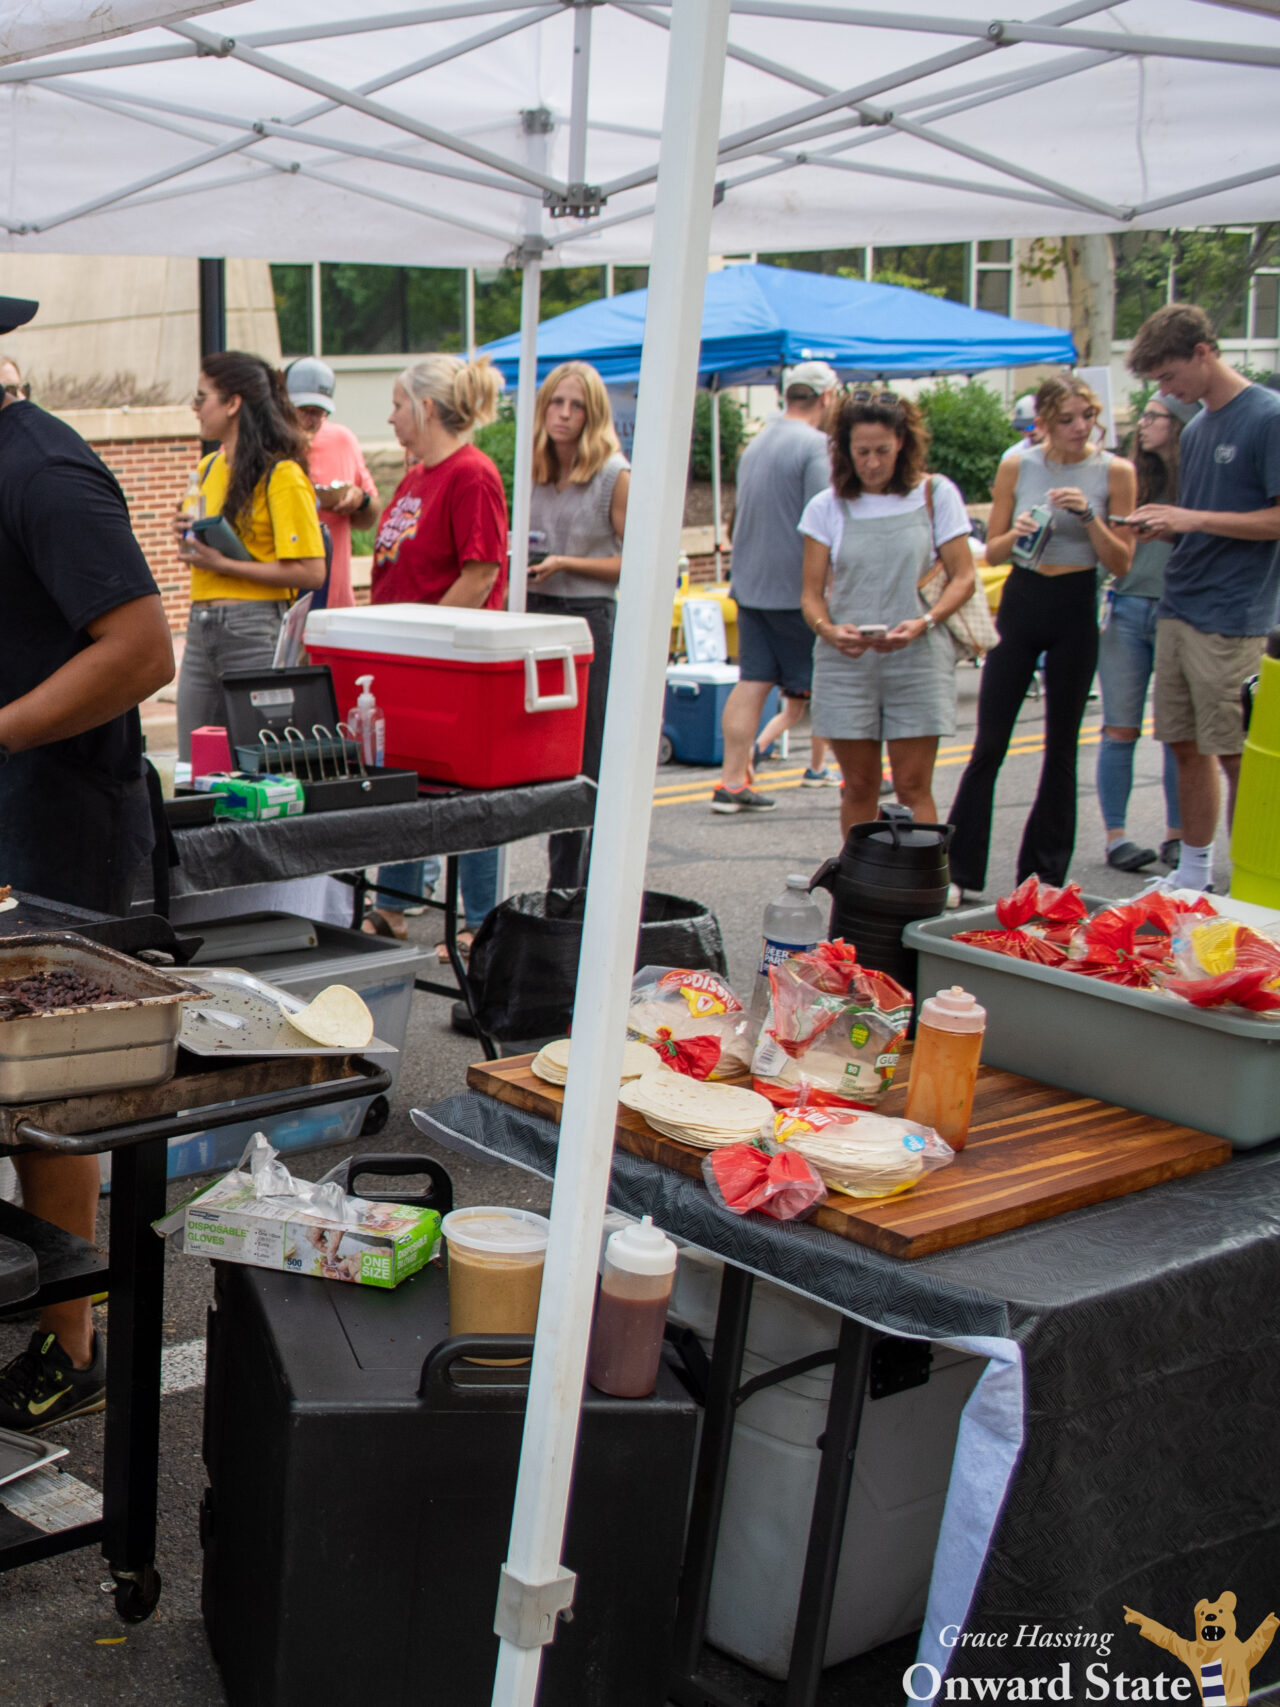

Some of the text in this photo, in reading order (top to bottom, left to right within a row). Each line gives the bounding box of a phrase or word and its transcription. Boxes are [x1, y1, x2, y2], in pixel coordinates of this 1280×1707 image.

[187, 1221, 247, 1238] DISPOSABLE
[187, 1232, 225, 1246] GLOVES
[287, 1257, 302, 1267] 500
[362, 1255, 390, 1269] ONE
[361, 1266, 390, 1280] SIZE
